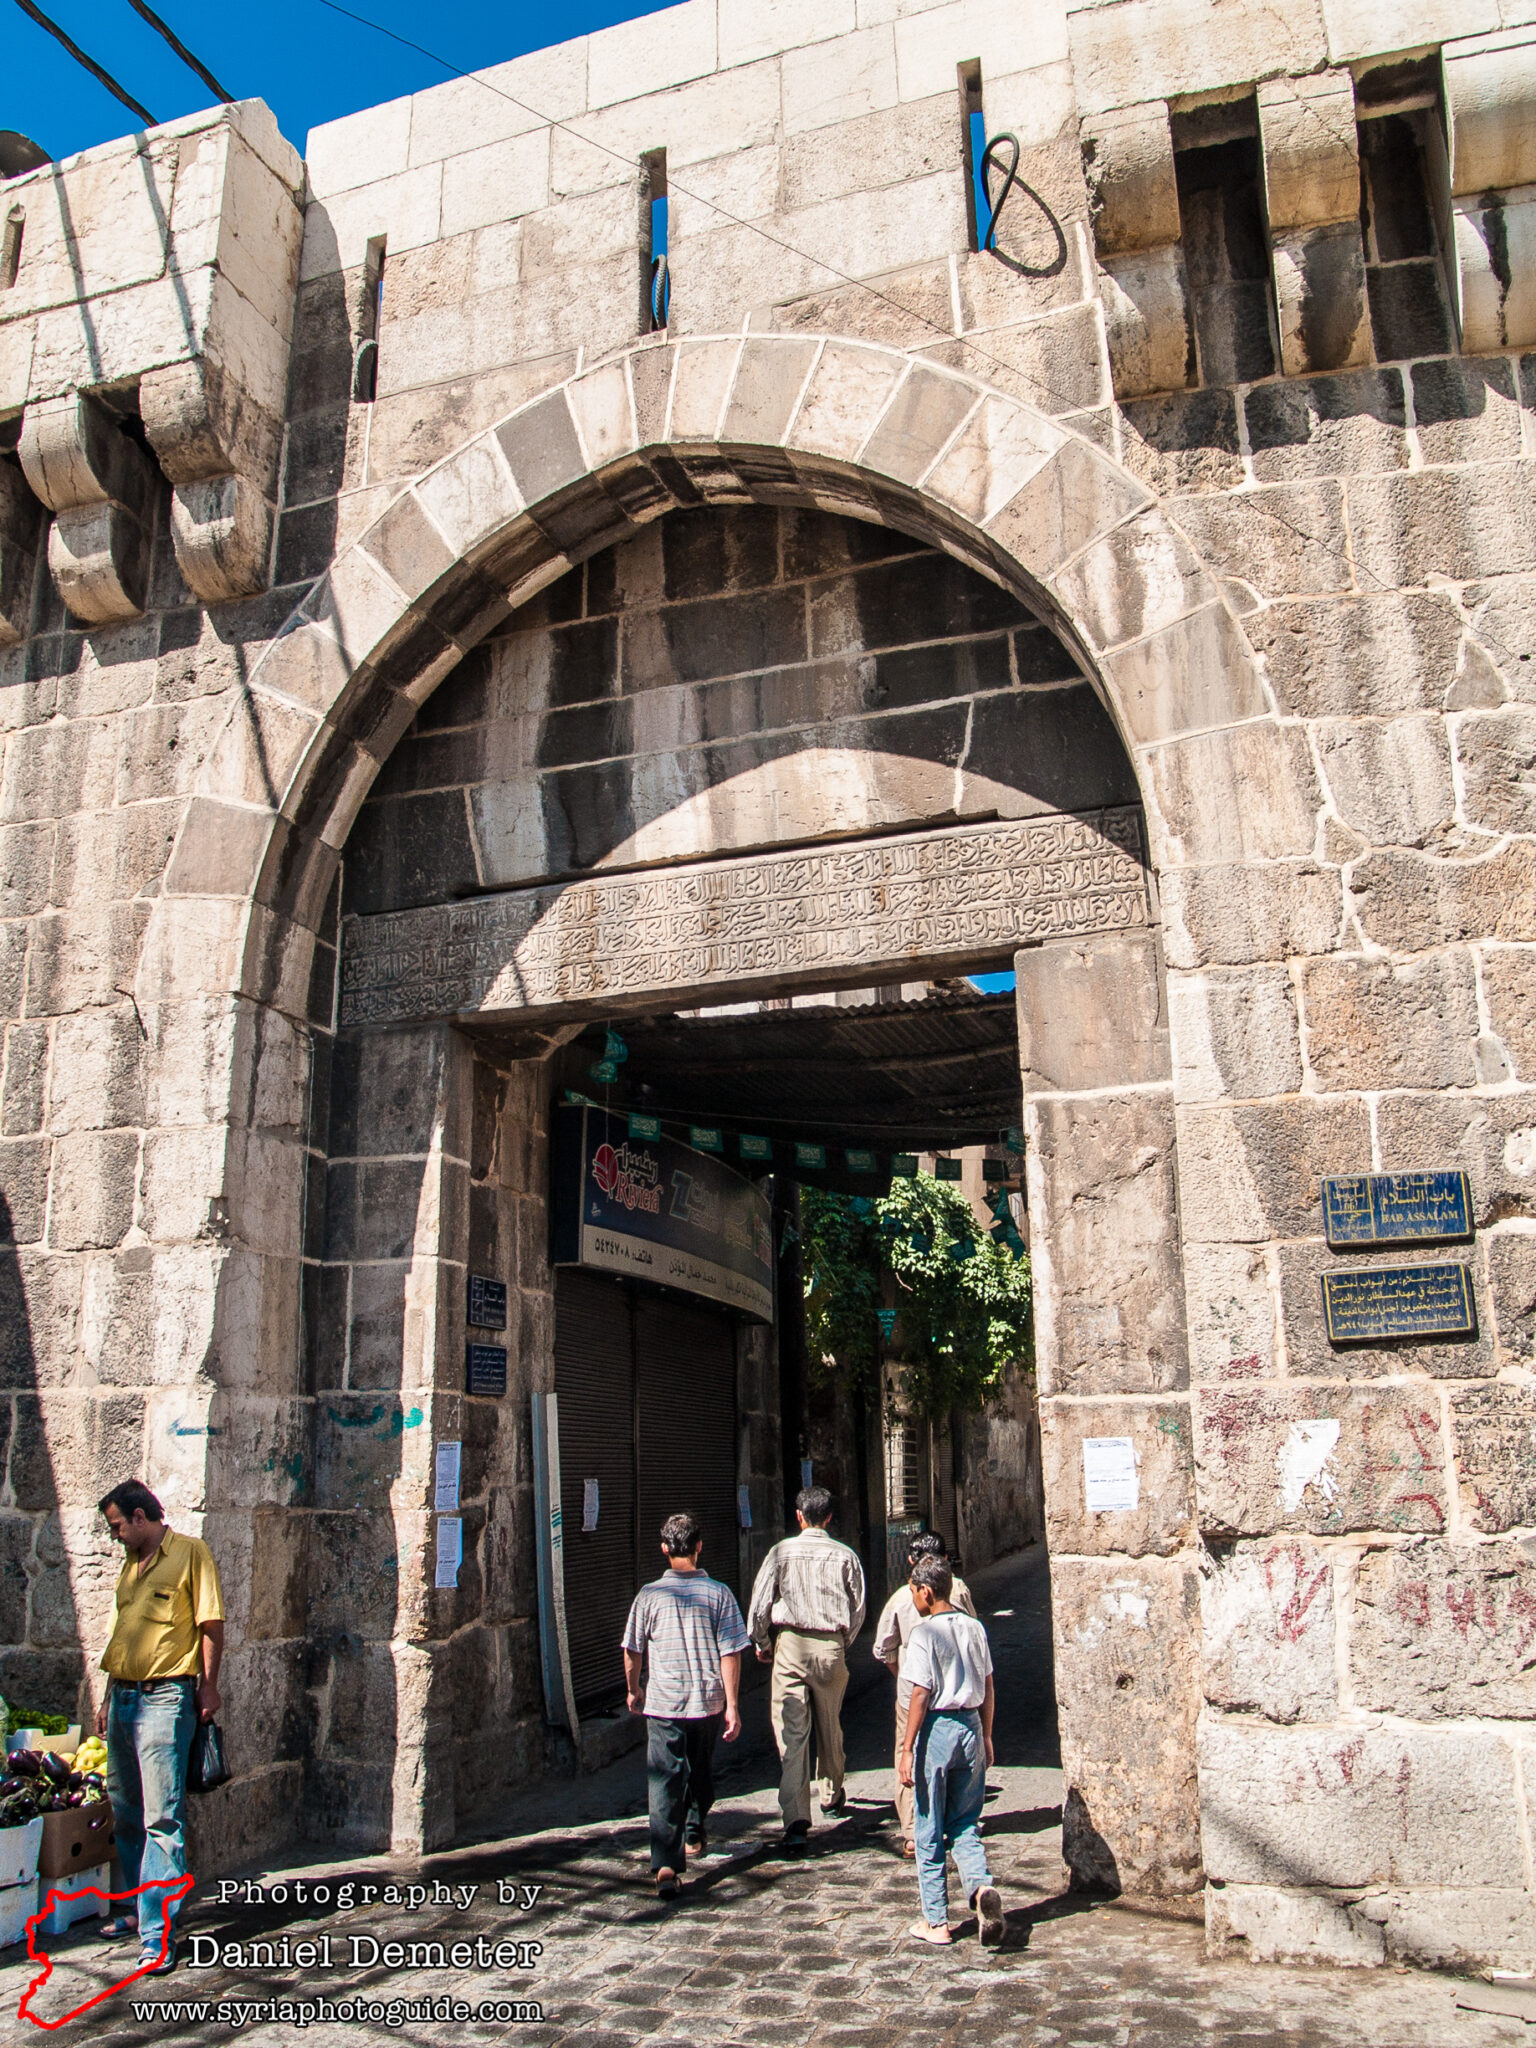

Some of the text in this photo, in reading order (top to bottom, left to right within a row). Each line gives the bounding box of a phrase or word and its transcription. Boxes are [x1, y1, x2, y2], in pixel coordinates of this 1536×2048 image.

[615, 1172, 664, 1214] Riviera
[1382, 1188, 1455, 1211] باب السلام
[1382, 1210, 1459, 1224] BAB ASSALAM
